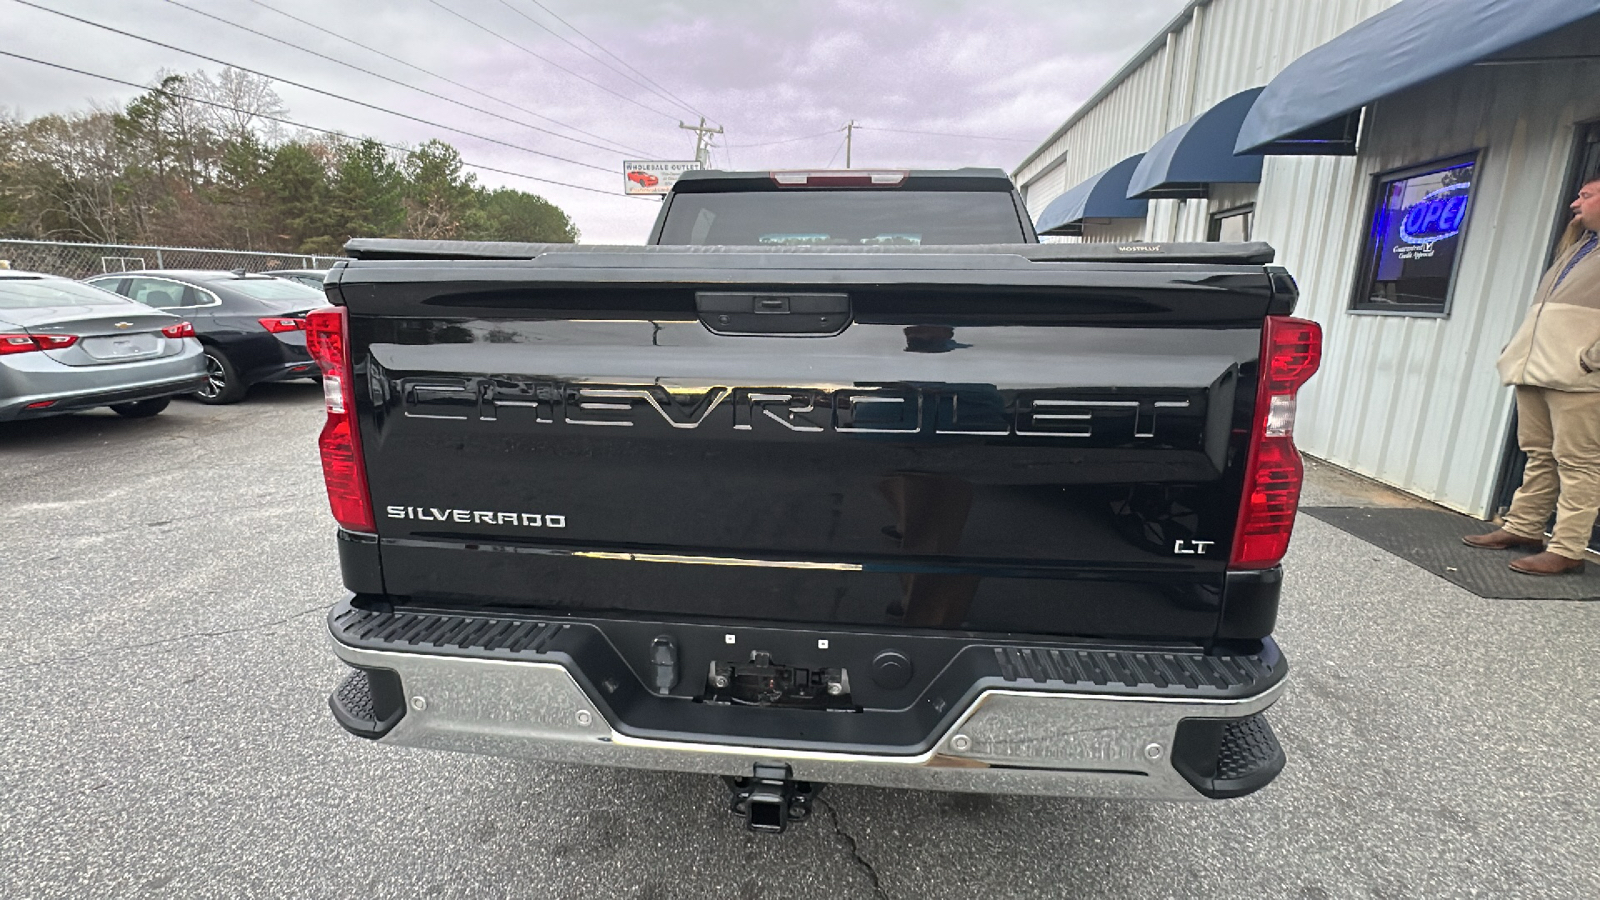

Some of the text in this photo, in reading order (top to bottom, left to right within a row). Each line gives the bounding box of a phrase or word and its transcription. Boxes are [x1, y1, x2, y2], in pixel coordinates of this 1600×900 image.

[626, 163, 669, 171] WHOLESALE
[401, 377, 1191, 437] CHEVROLET
[386, 505, 566, 528] SILVERADO
[1174, 539, 1215, 554] LT
